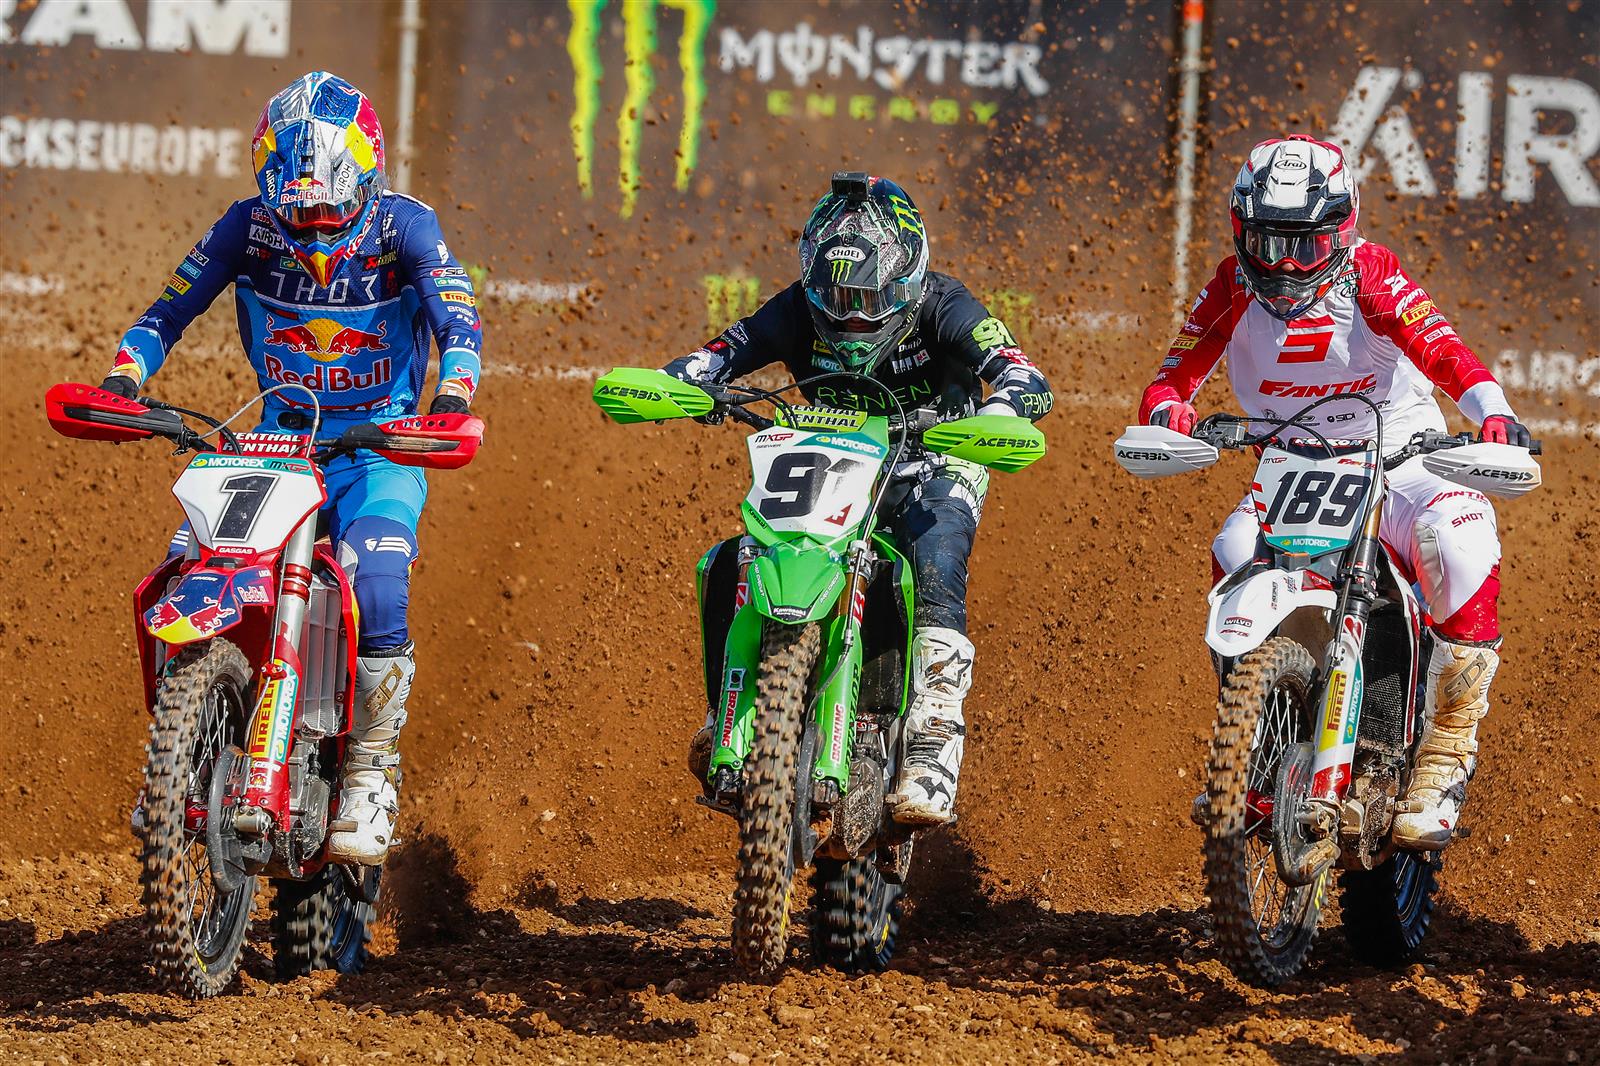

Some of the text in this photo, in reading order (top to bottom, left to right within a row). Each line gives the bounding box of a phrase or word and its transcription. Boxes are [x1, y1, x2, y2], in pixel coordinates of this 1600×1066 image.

[718, 22, 1050, 96] MONSTER
[766, 90, 999, 125] ENERGY
[1279, 160, 1304, 168] Arai
[265, 169, 277, 200] AIROH
[337, 164, 353, 197] AIROH
[281, 191, 328, 204] Red Bull
[831, 248, 860, 258] SHOEI
[264, 352, 391, 392] Red Bull
[598, 384, 662, 402] ACERBIS
[1258, 373, 1377, 398] FANTIC
[794, 405, 860, 417] ENTHAL
[1335, 413, 1356, 422] SIDI
[794, 413, 859, 427] ENTHAL
[232, 432, 302, 442] ENTHAL
[755, 433, 881, 455] MXGP MOTOREX
[974, 438, 1040, 448] ACERBIS
[1117, 450, 1170, 460] ACERBIS
[208, 457, 310, 472] MOTOREX MXGP
[1469, 468, 1535, 481] ACERBIS
[212, 472, 281, 542] 1
[1263, 470, 1372, 527] 189
[1451, 512, 1485, 528] SHOT
[1292, 538, 1331, 547] MOTOREX
[1225, 618, 1252, 627] WILVO
[1326, 673, 1347, 731] PIRELLI
[1349, 678, 1362, 724] MOTOREX
[721, 690, 739, 748] BRAKING
[830, 703, 847, 765] BRAKING
